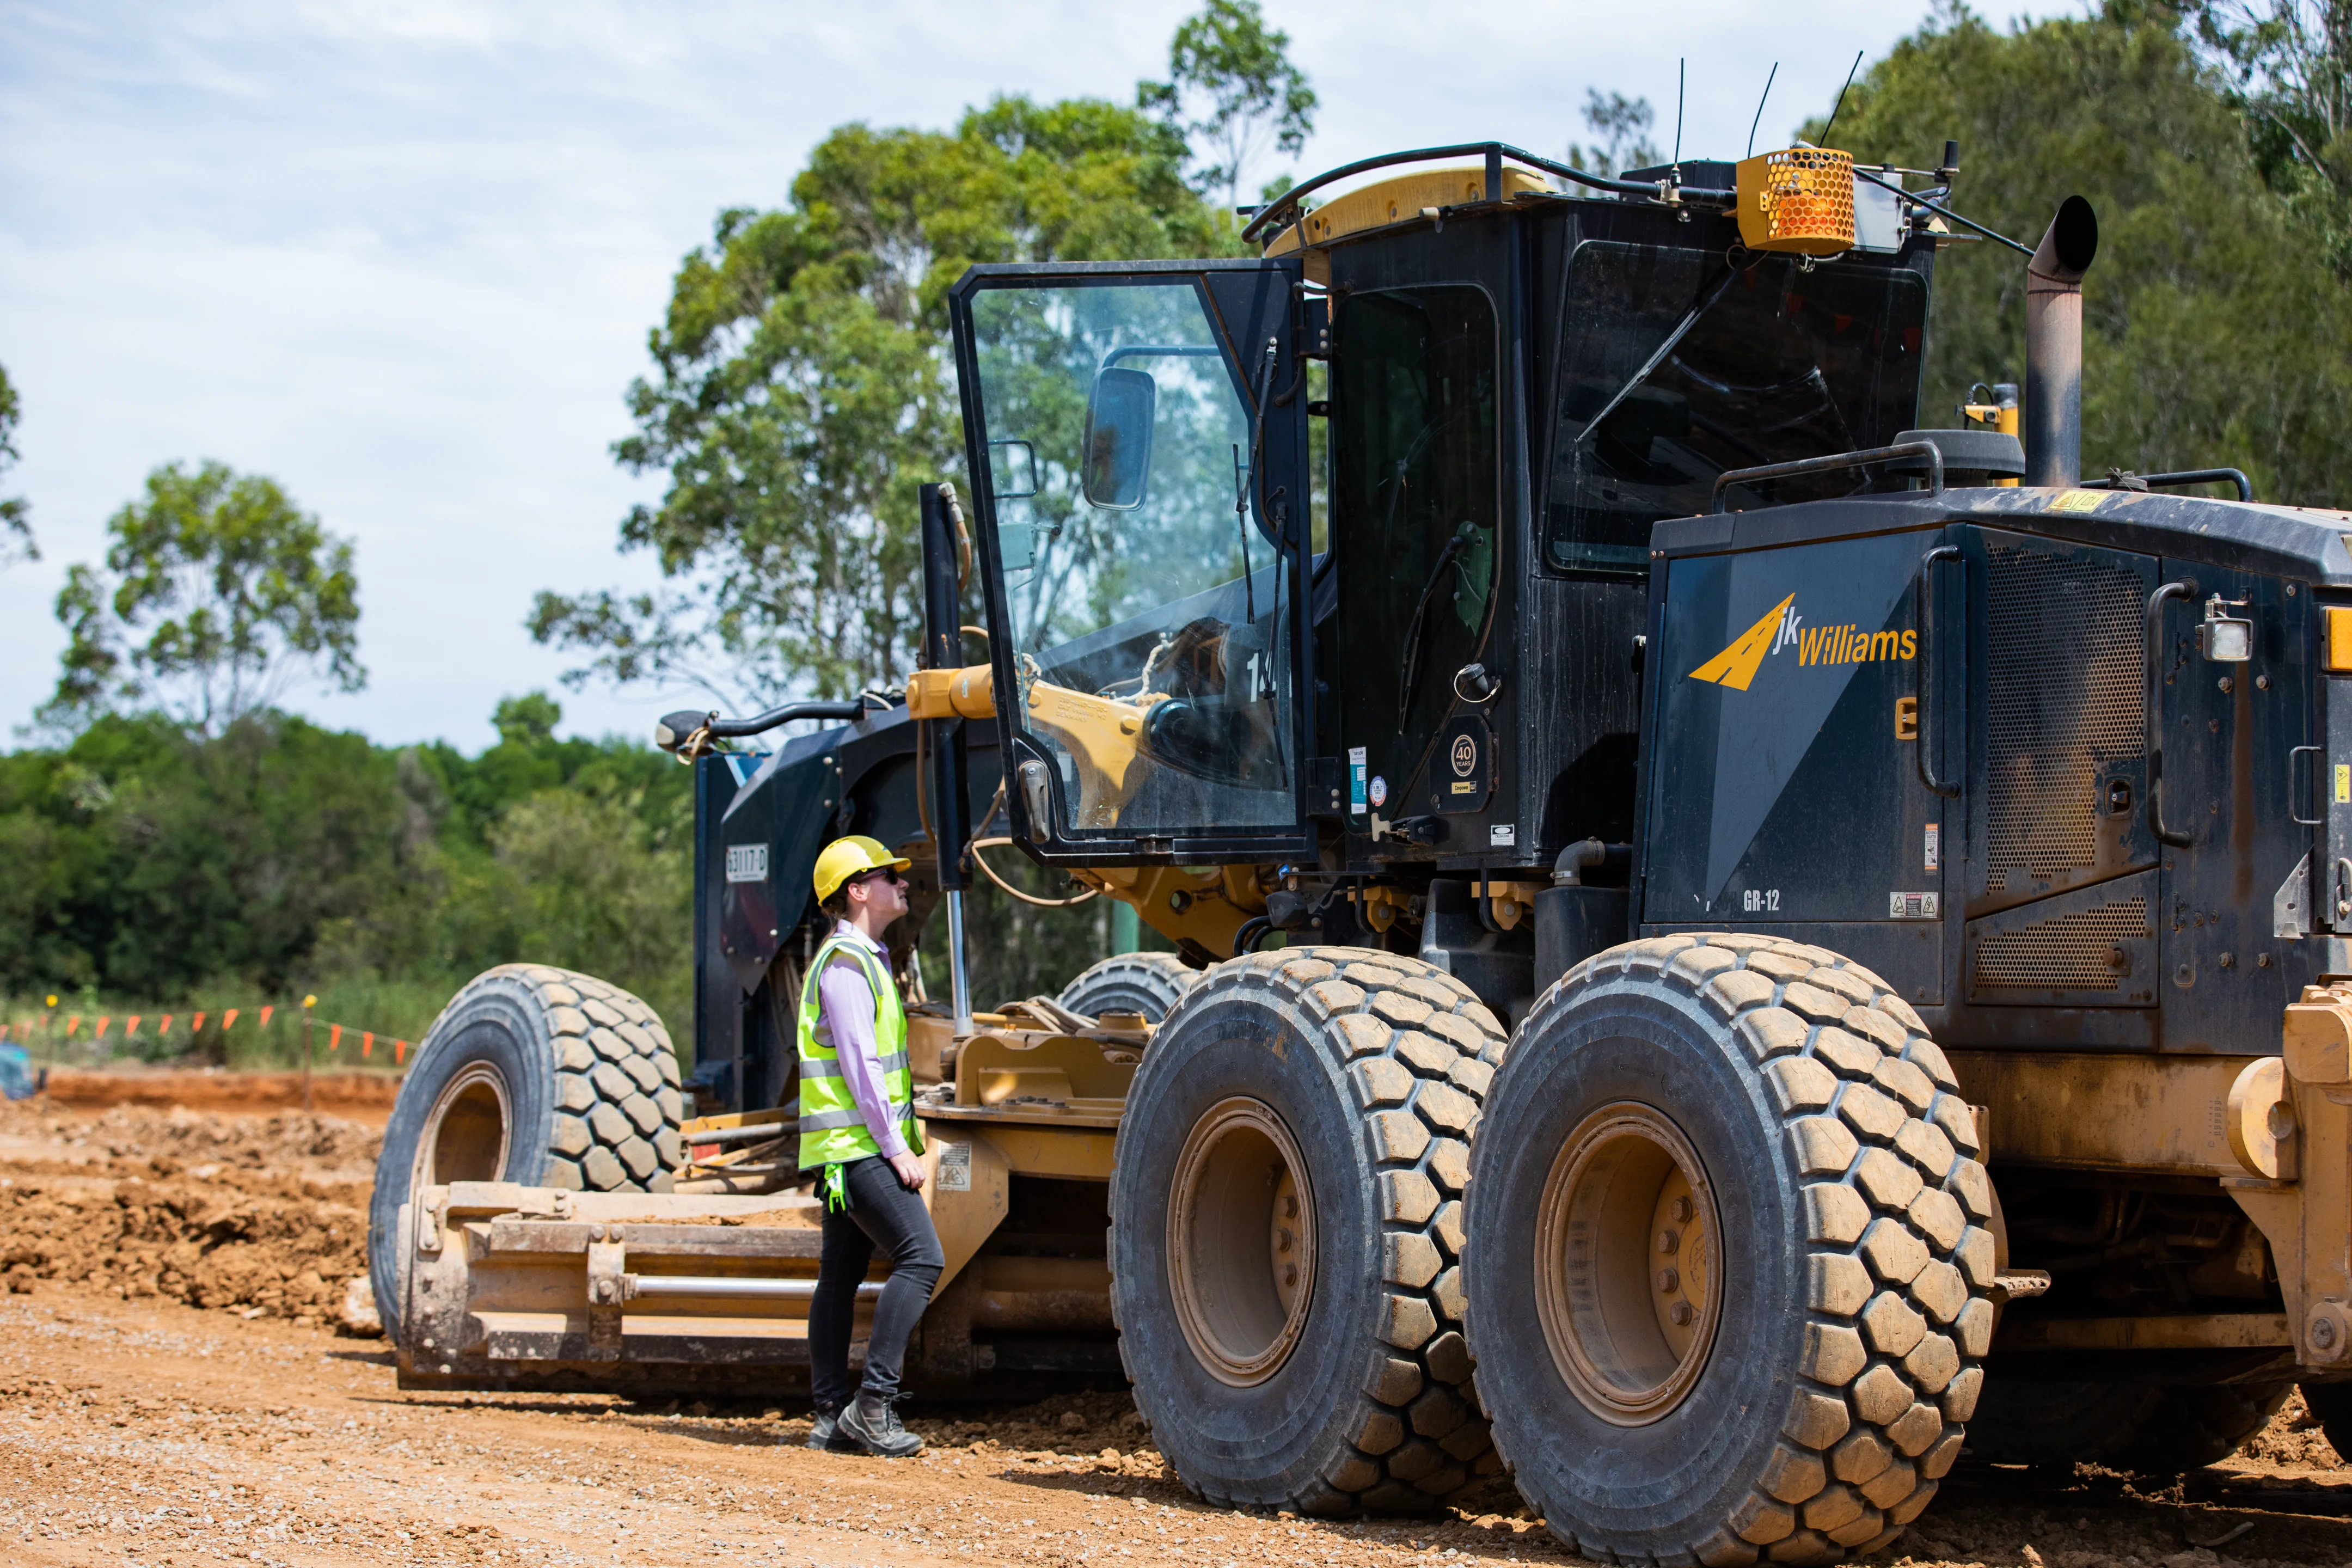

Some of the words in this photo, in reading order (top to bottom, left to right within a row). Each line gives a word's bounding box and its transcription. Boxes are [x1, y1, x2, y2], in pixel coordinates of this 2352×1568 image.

[1772, 606, 1802, 655] jk
[1799, 624, 1917, 666] Williams
[1456, 746, 1471, 760] 40
[1744, 890, 1779, 912] GR-12
